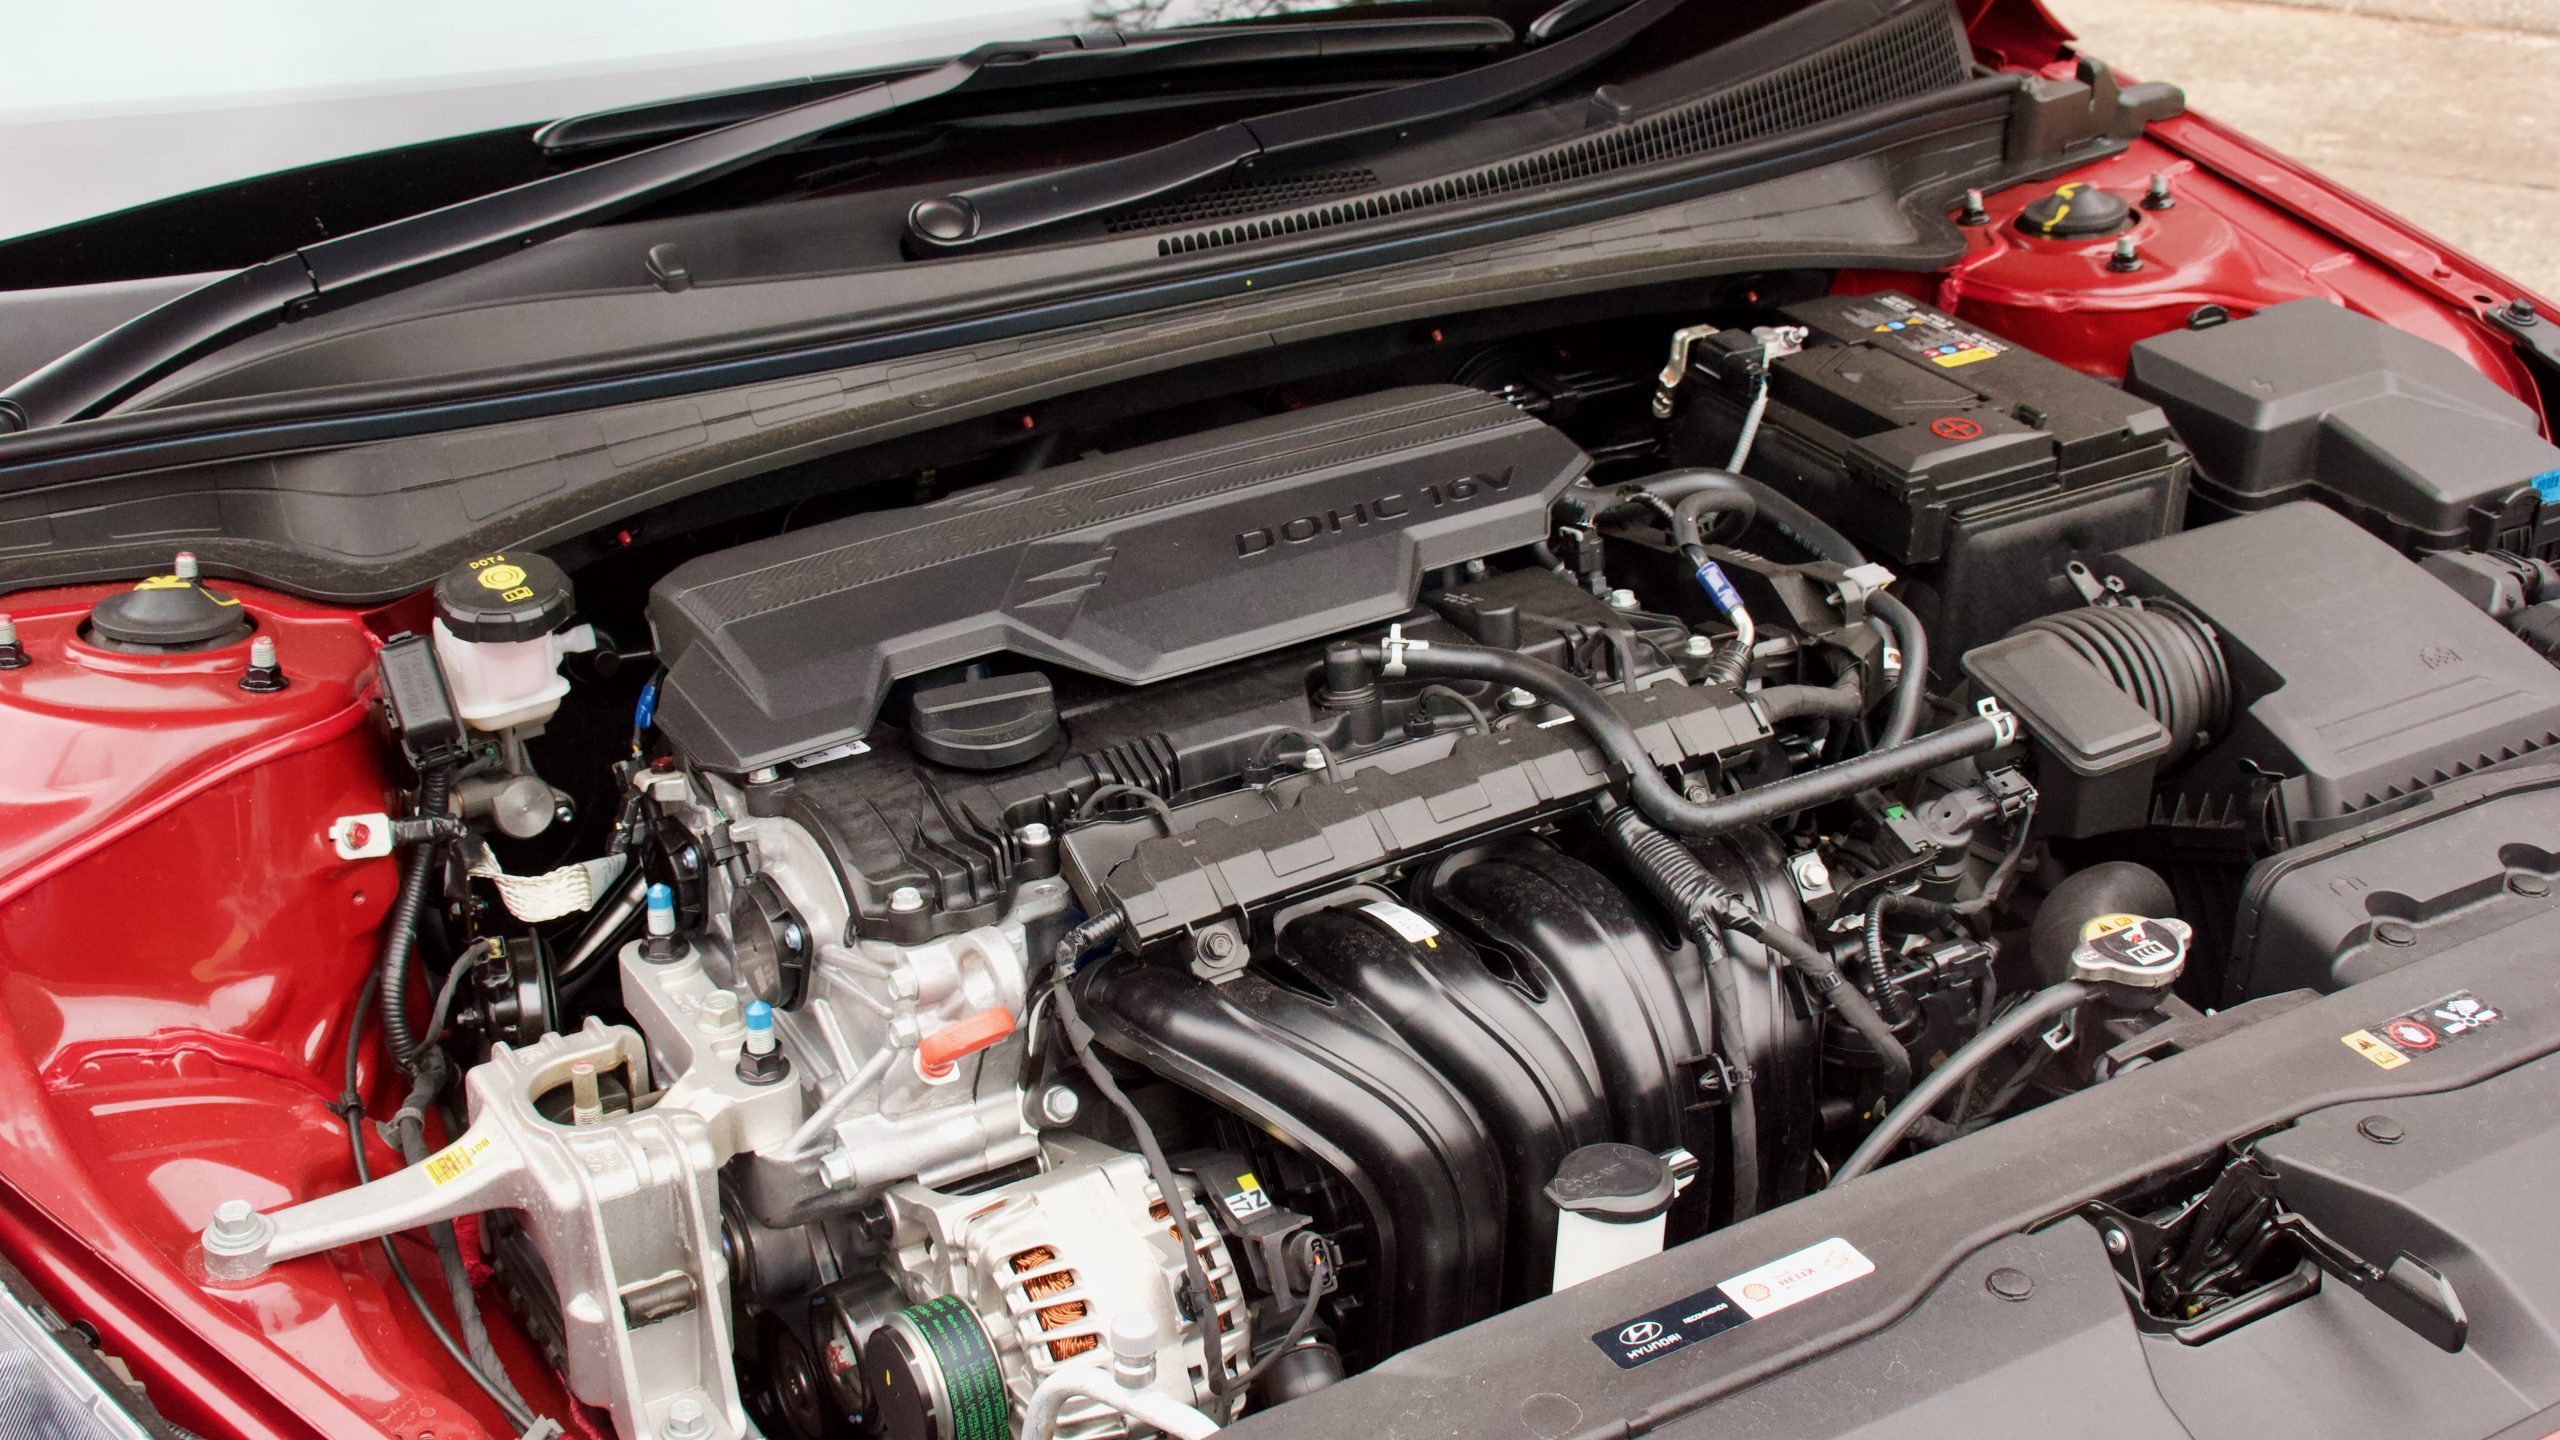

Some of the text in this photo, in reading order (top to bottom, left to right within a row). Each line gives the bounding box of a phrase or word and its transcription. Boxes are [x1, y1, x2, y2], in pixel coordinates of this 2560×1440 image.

[1234, 464, 1515, 559] DOHC 16V
[1778, 1268, 1816, 1286] HELIX
[1627, 1332, 1682, 1360] HYUNDAI
